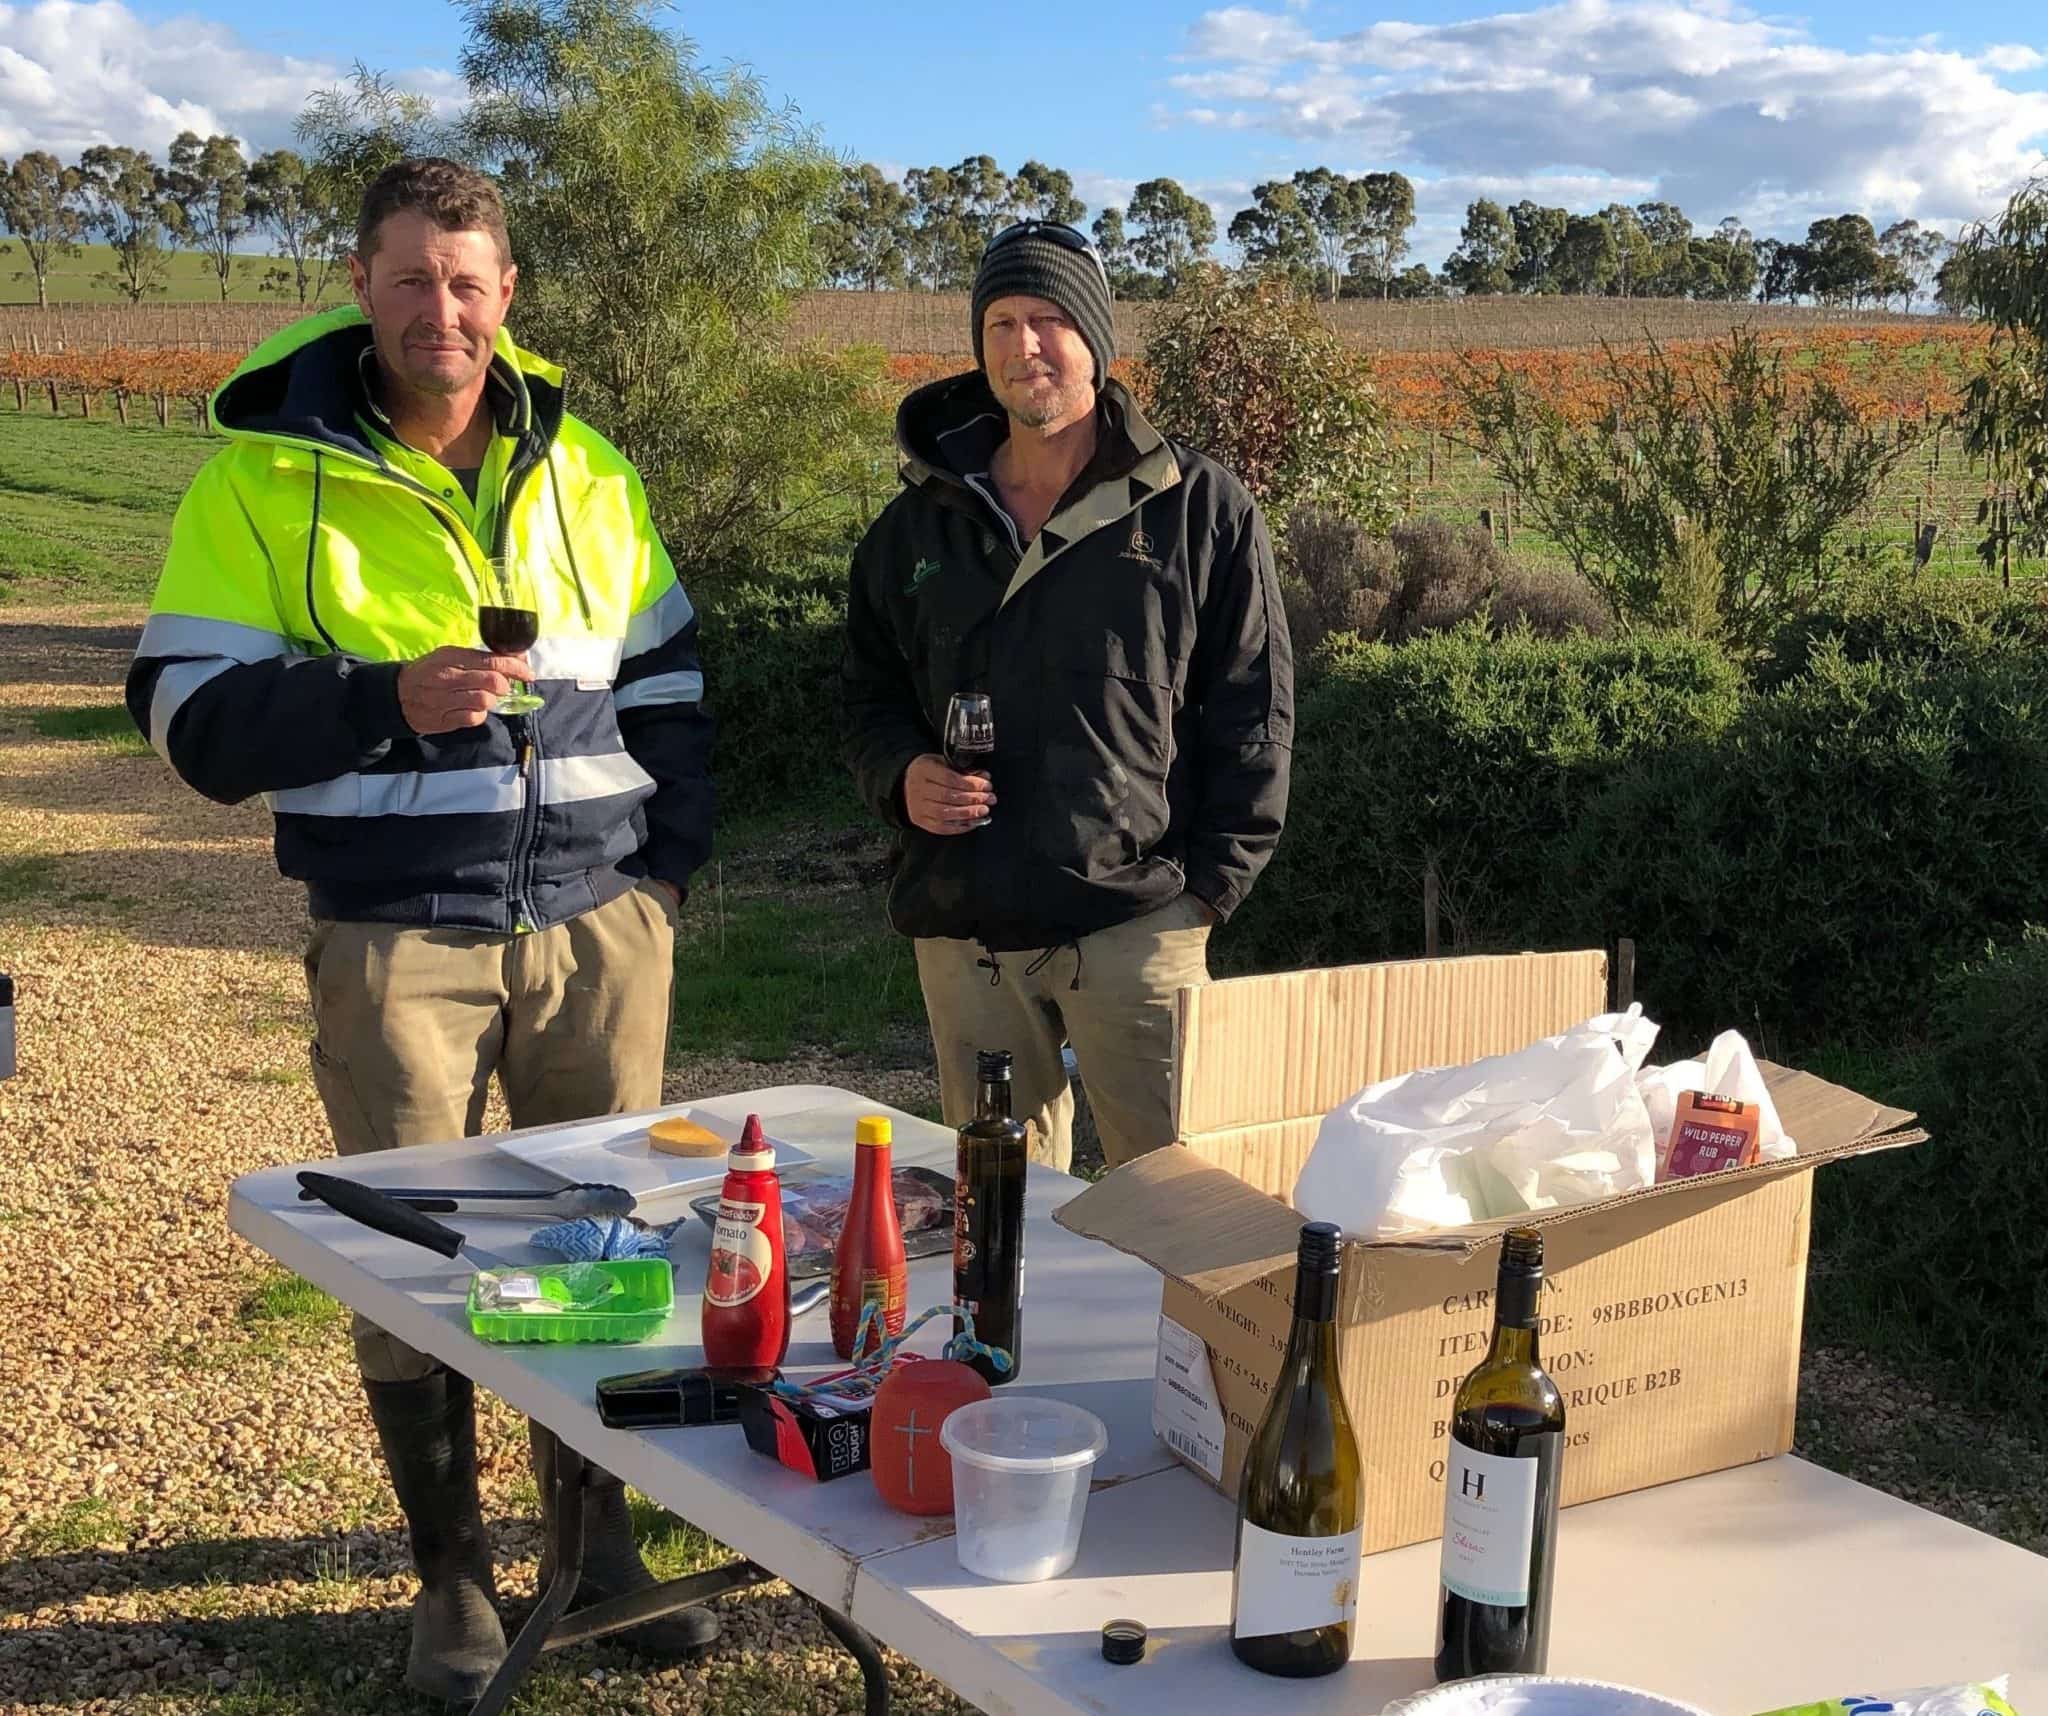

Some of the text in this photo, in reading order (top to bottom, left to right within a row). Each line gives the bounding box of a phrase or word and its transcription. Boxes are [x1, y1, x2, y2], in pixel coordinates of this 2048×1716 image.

[1683, 1126, 1743, 1147] WILD PEPPER
[1698, 1145, 1719, 1159] RUB
[1216, 1299, 1261, 1339] WEIGHT:
[1591, 1278, 1748, 1326] 98BBBOXGEN13
[1644, 1367, 1682, 1392] B2B
[829, 1421, 849, 1474] BBQ
[850, 1424, 860, 1465] TOUGH
[1461, 1467, 1486, 1501] H
